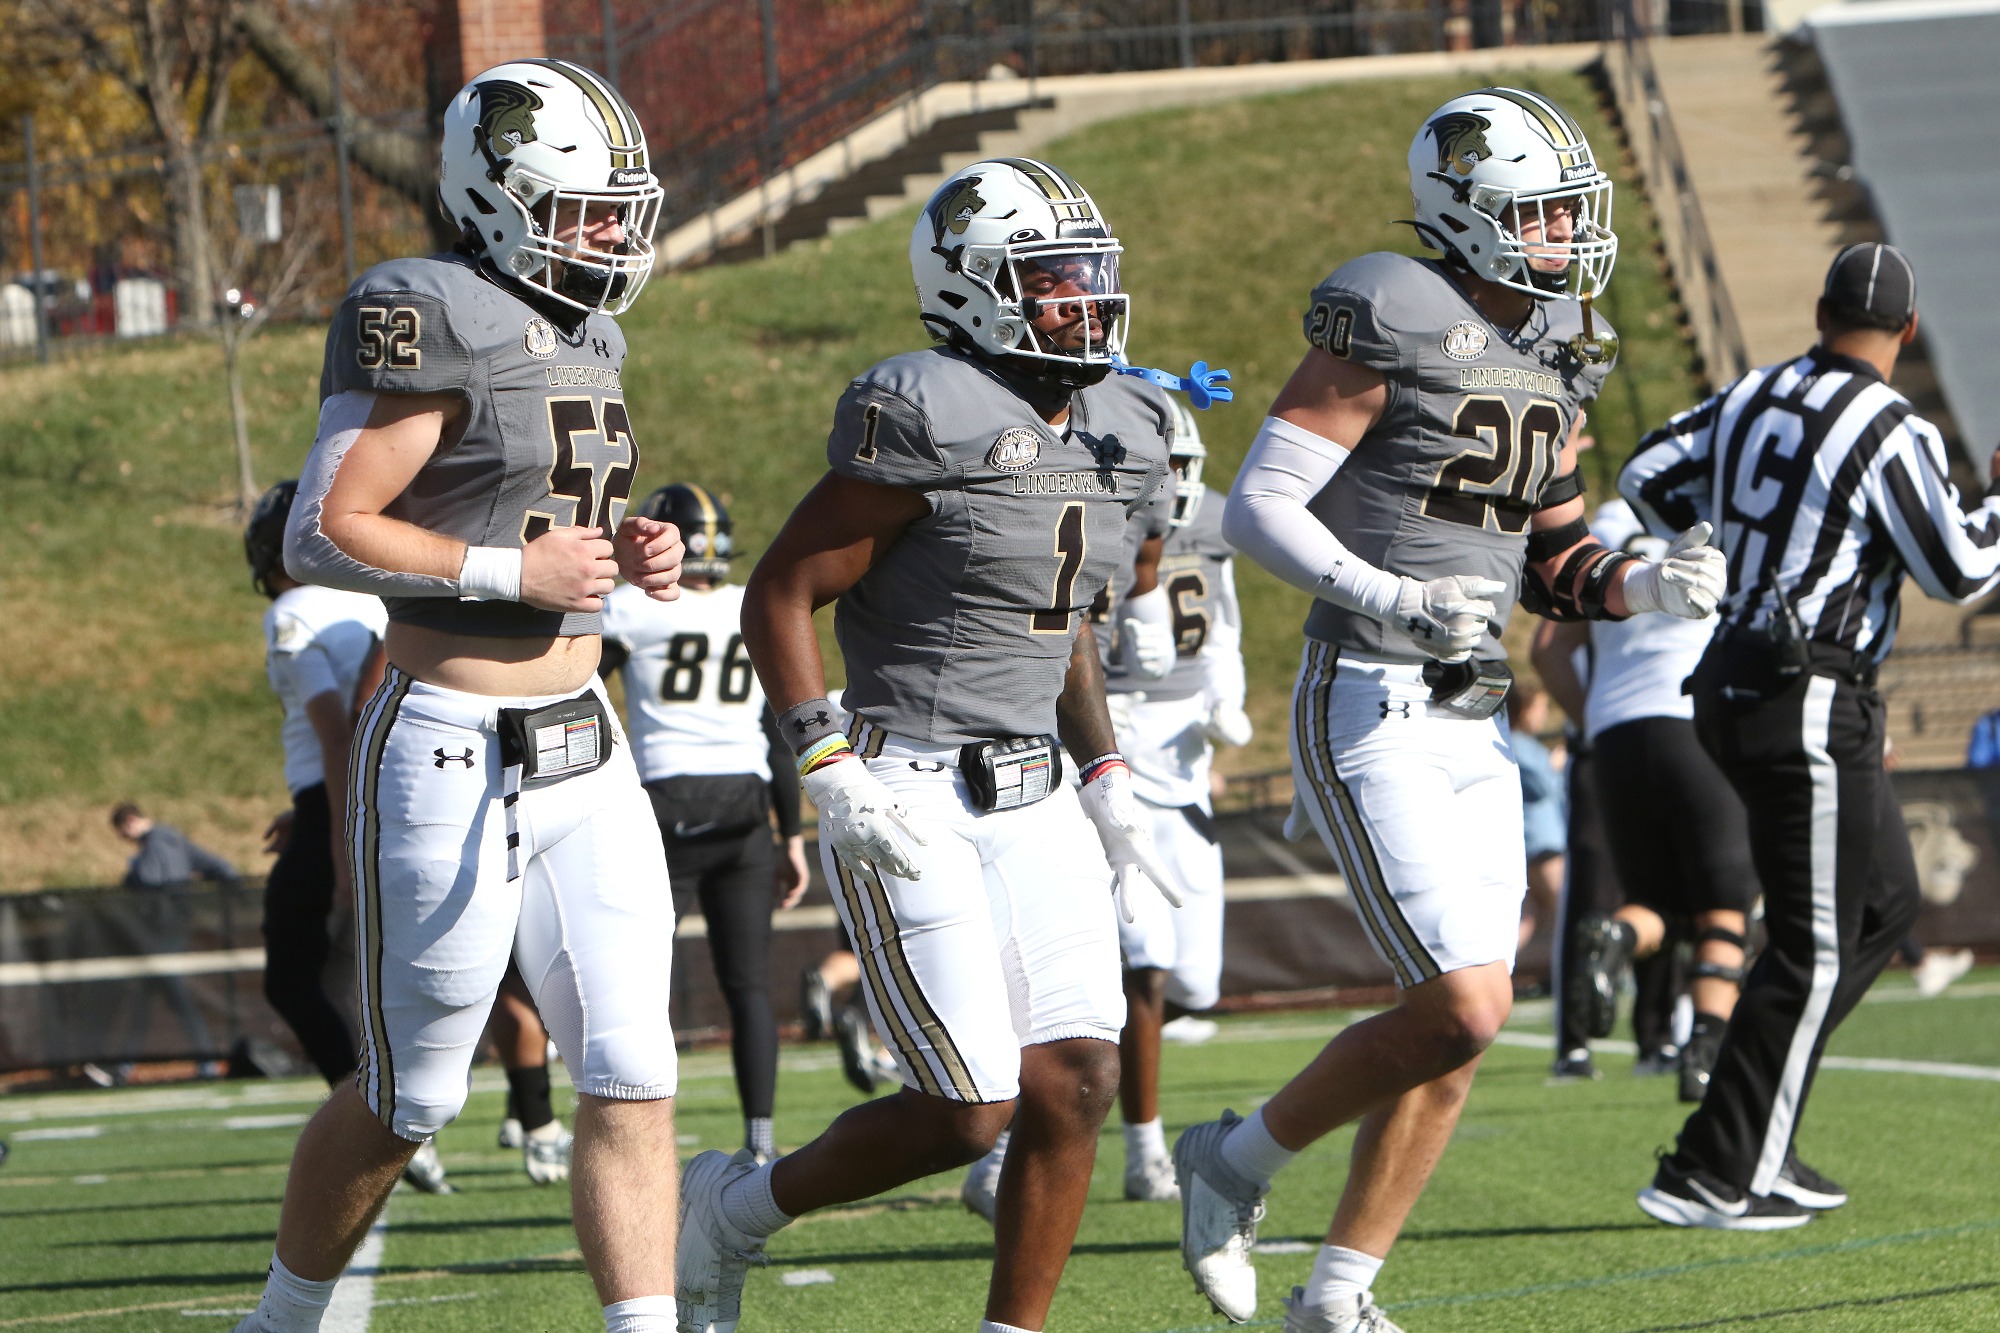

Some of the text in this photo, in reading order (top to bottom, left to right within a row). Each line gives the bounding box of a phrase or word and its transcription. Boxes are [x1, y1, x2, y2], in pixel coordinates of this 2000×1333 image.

[1566, 165, 1595, 180] Riddell
[356, 307, 420, 370] 52
[1308, 302, 1356, 360] 20
[1460, 367, 1561, 397] LINDENWOOD
[855, 402, 882, 464] 1
[1420, 394, 1562, 534] 20
[1733, 406, 1805, 520] C
[519, 395, 640, 546] 52
[1013, 473, 1120, 495] LINDENWOOD
[1029, 501, 1086, 634] 1
[660, 632, 753, 703] 86
